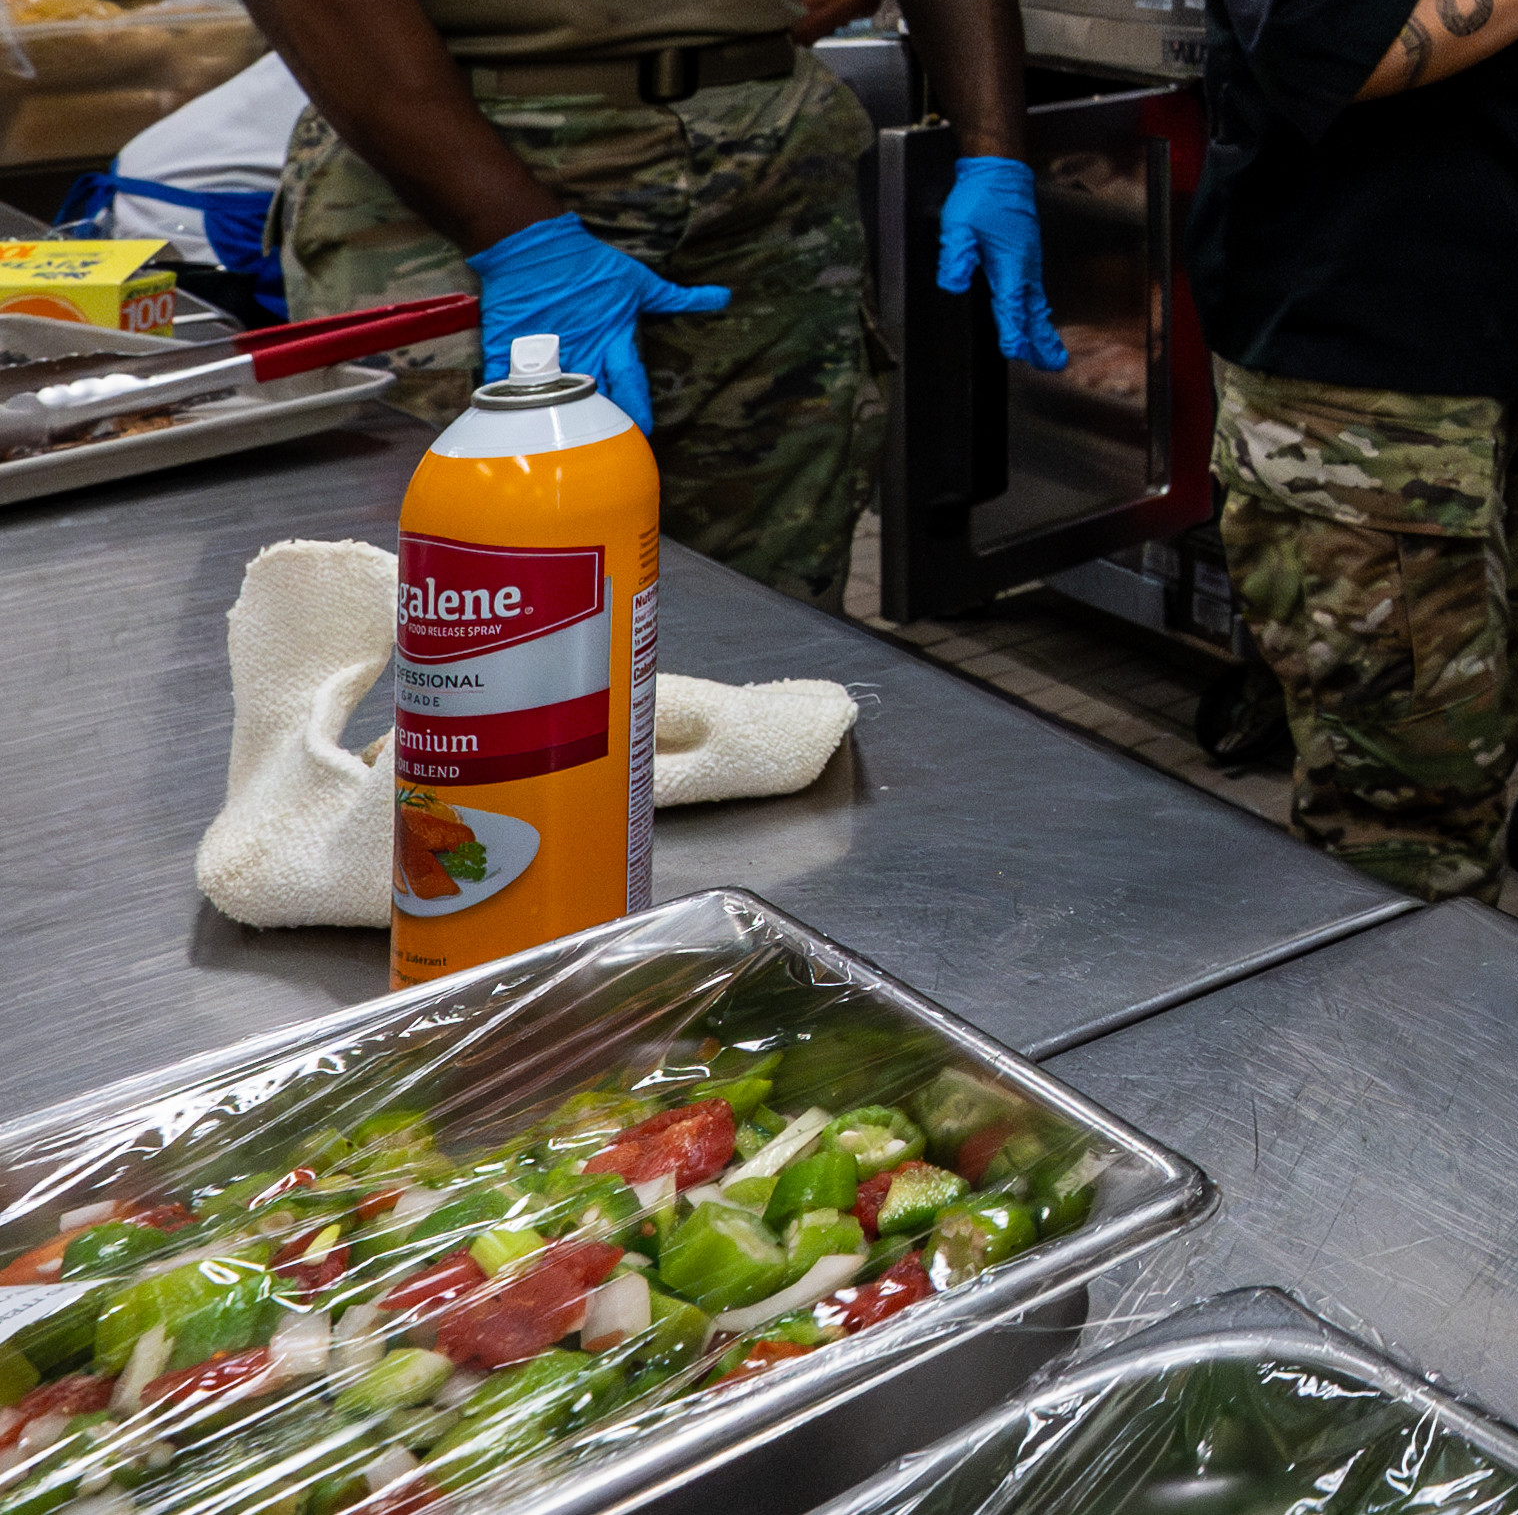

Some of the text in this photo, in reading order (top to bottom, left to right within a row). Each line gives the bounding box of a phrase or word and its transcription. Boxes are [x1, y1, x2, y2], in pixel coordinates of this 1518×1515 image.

[122, 293, 174, 333] 100
[408, 622, 502, 637] FOOD RELEASE SPRAY
[402, 689, 441, 707] GRADE
[413, 762, 460, 778] BLEND
